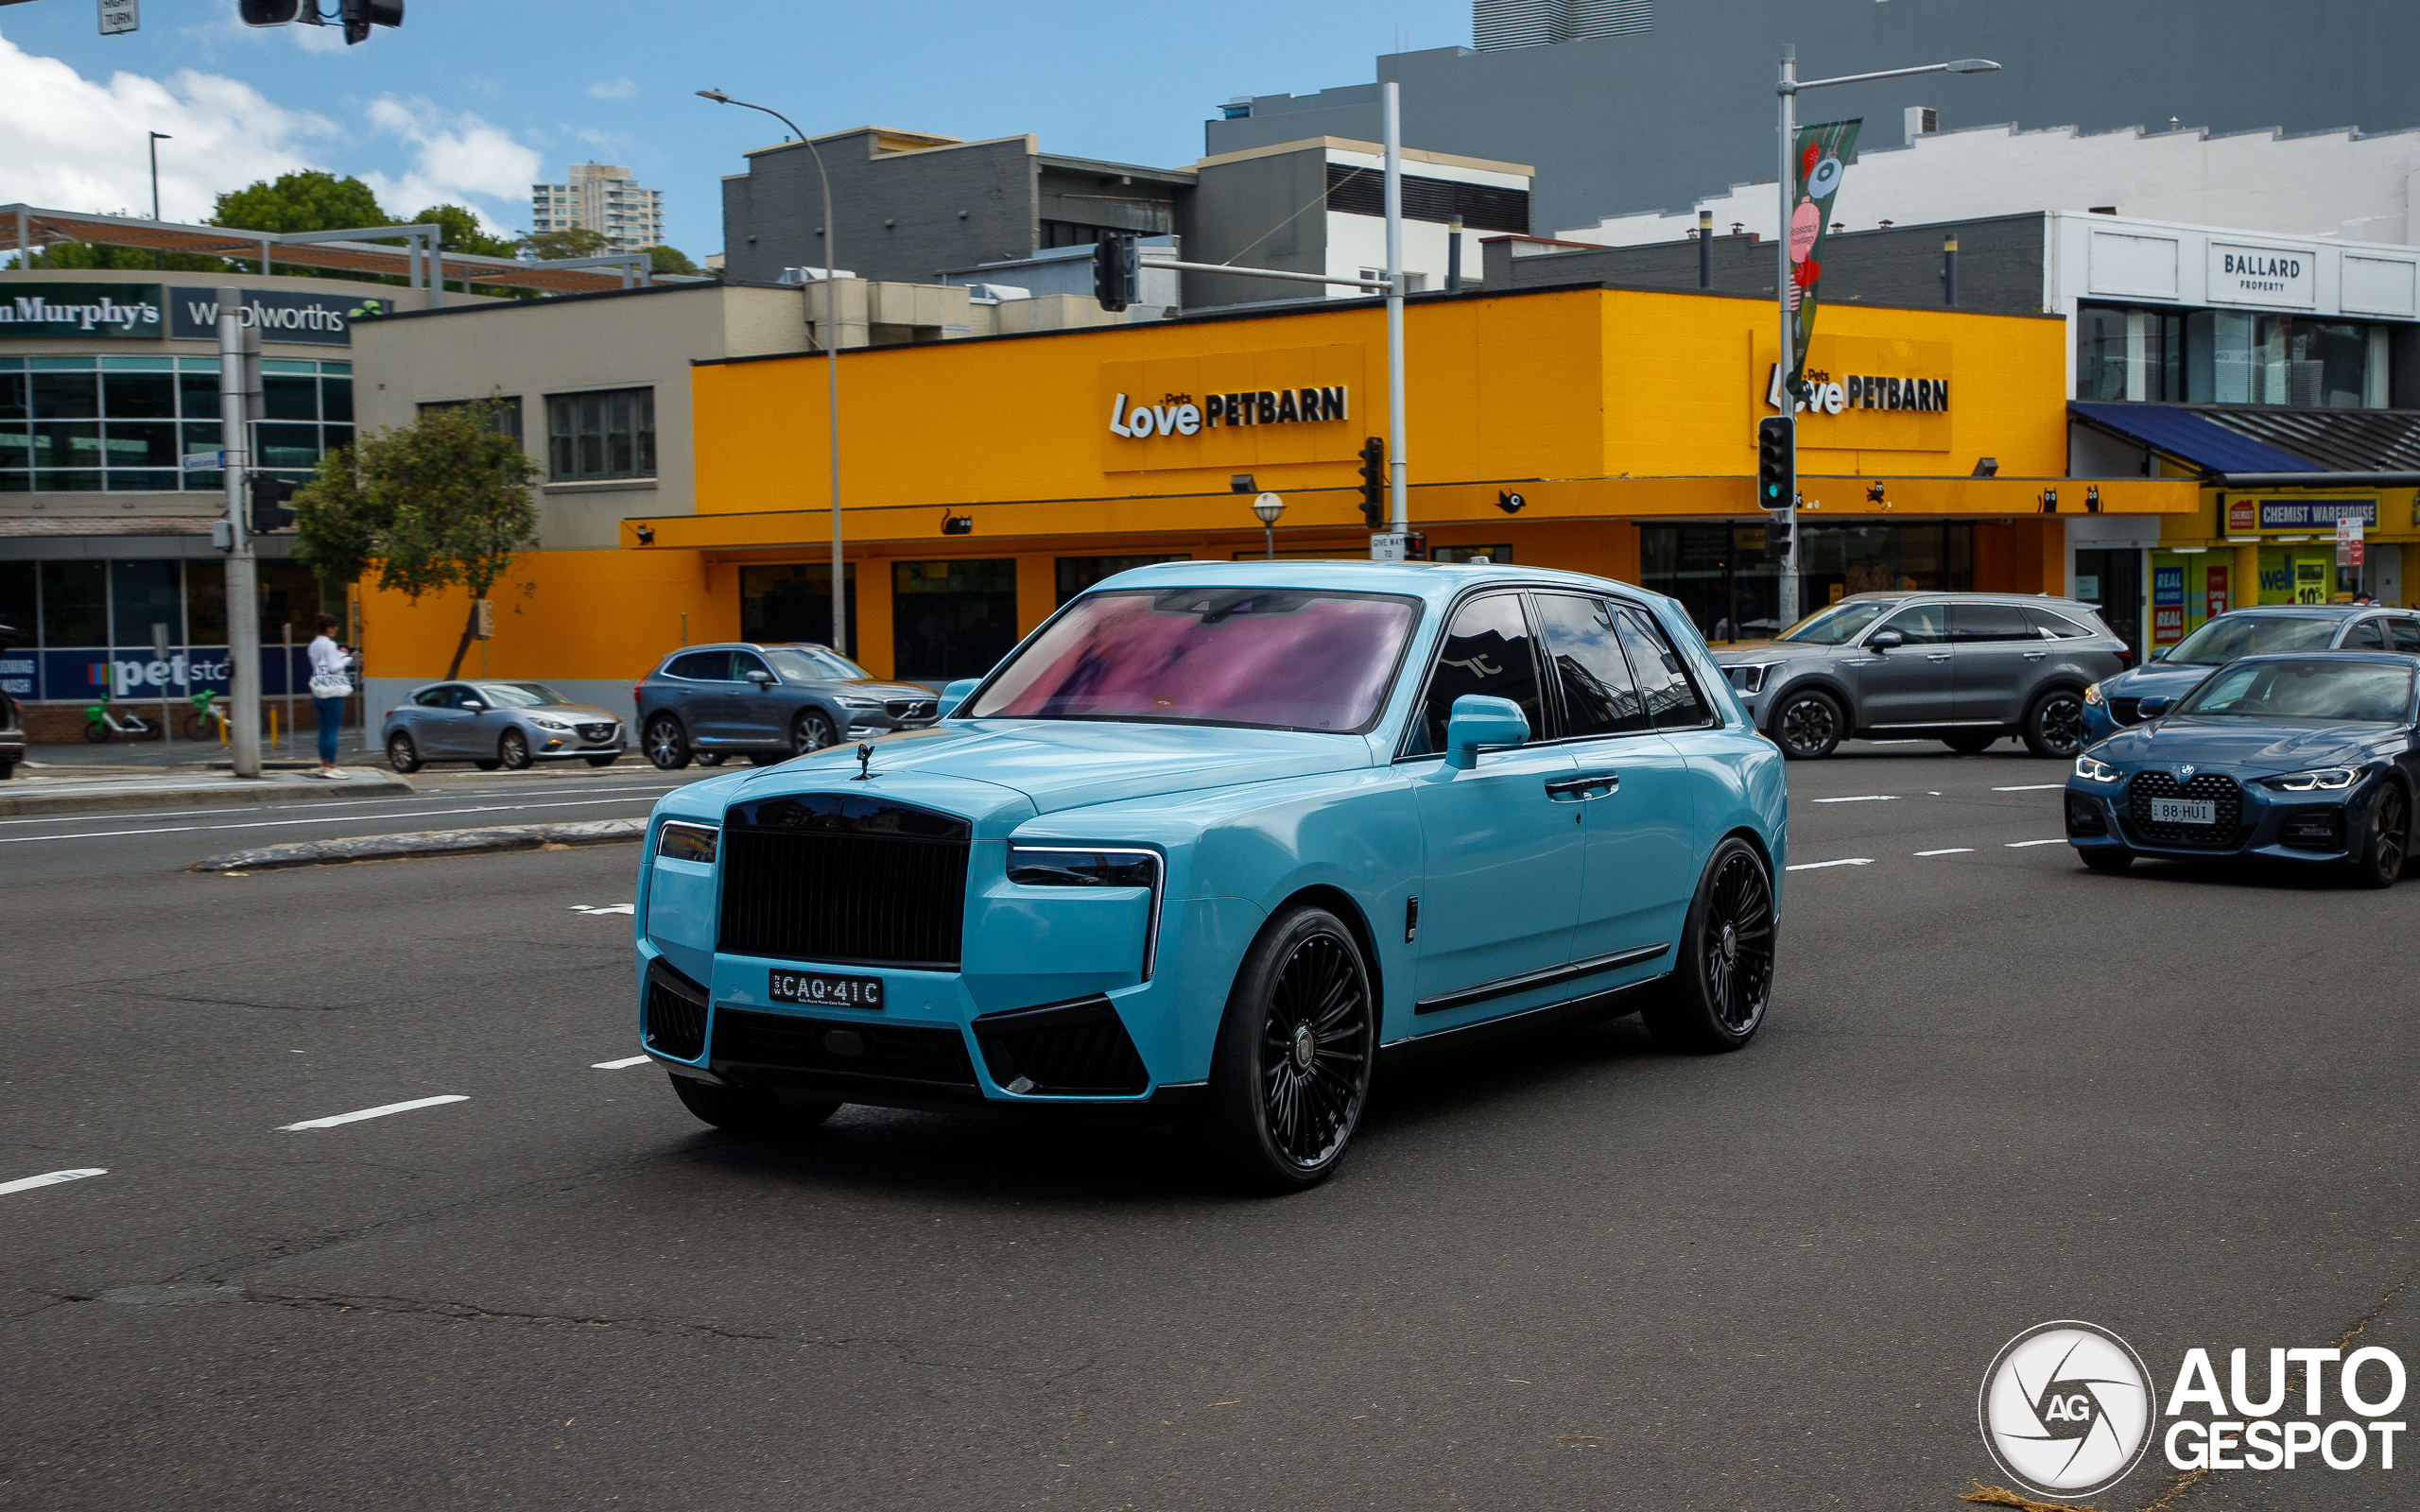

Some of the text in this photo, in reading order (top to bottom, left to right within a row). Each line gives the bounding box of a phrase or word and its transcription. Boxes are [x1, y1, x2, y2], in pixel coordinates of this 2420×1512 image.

[104, 11, 133, 26] TURN
[2224, 253, 2300, 279] BALLARD
[2239, 280, 2285, 292] PROPERTY
[188, 299, 344, 332] Wolworths
[1808, 369, 1830, 383] Pets
[1165, 392, 1192, 405] Pets
[1842, 374, 1948, 413] PETBARN
[1109, 386, 1349, 438] Love PETBARN
[2263, 505, 2376, 523] CHEMIST WAREHOUSE
[2156, 573, 2181, 589] REAL
[2156, 610, 2181, 627] REAL
[112, 654, 188, 696] pet
